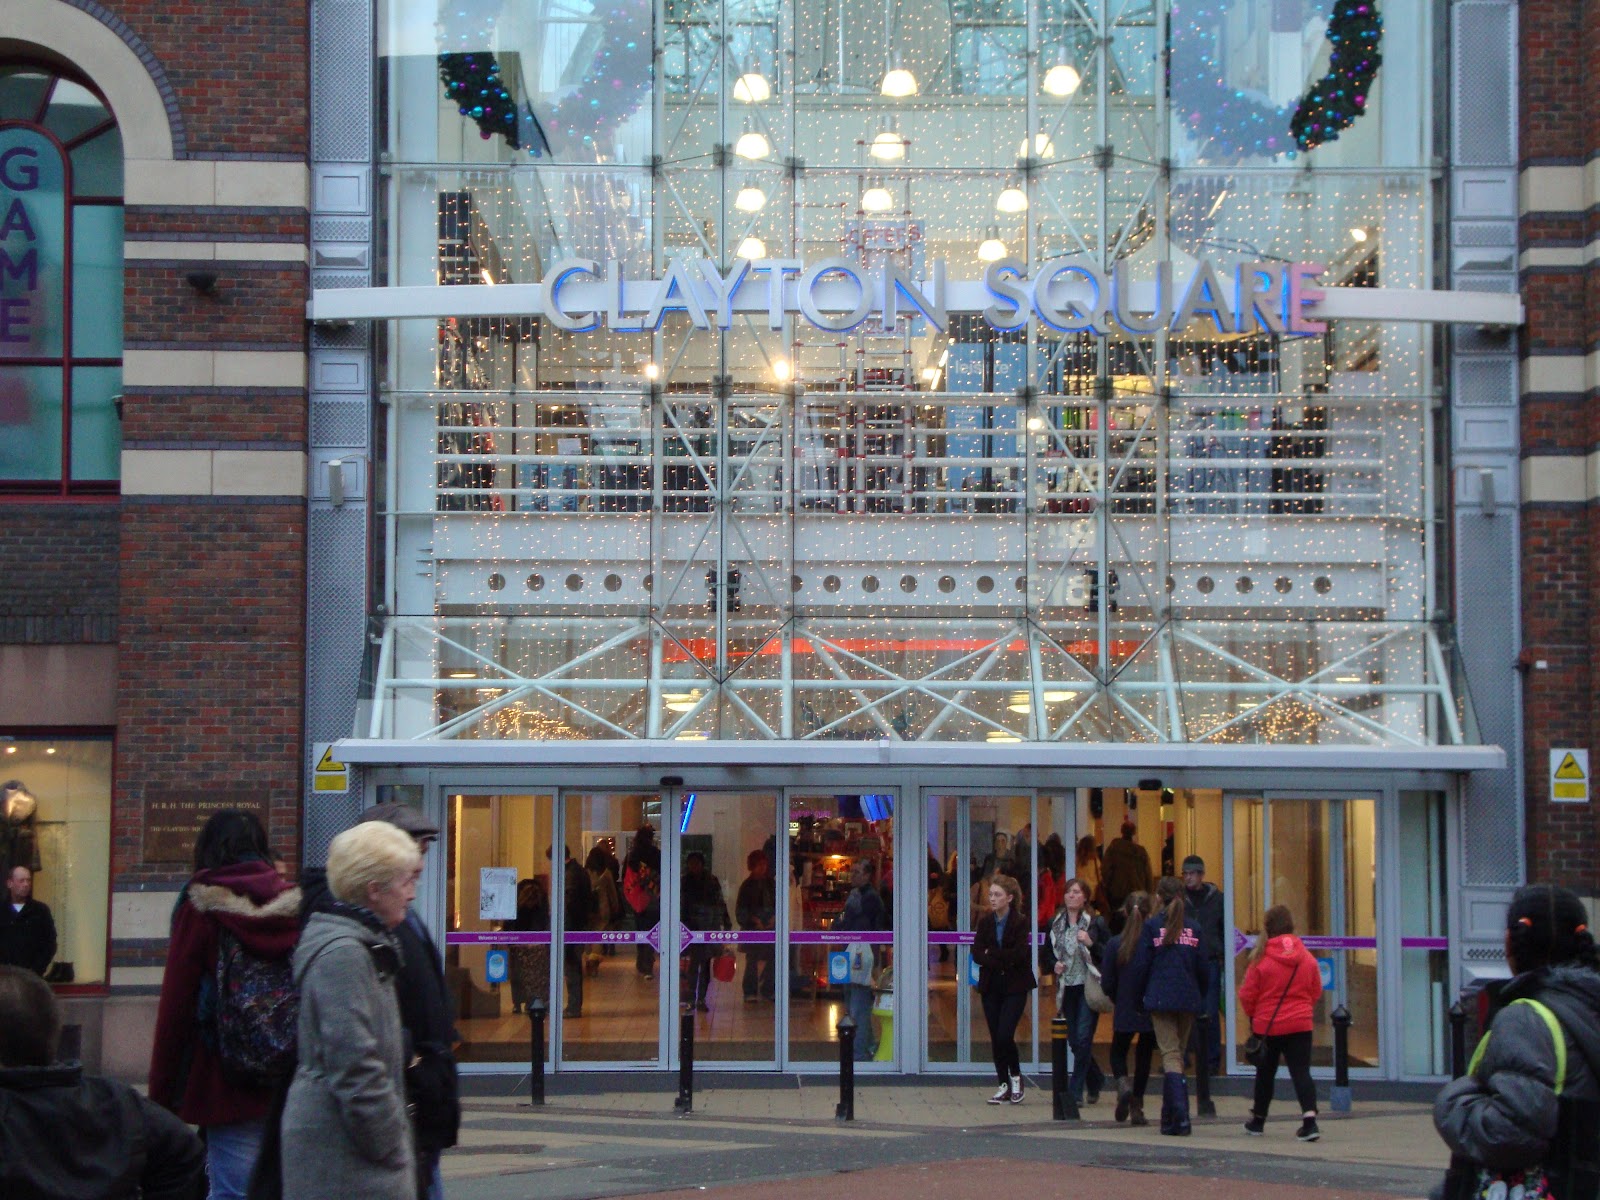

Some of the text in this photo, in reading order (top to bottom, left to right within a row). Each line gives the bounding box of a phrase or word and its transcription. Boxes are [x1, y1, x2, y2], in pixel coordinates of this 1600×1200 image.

[0, 147, 39, 342] GAME
[541, 257, 1328, 337] CLAYTON SQUARE
[955, 360, 1009, 375] leisre
